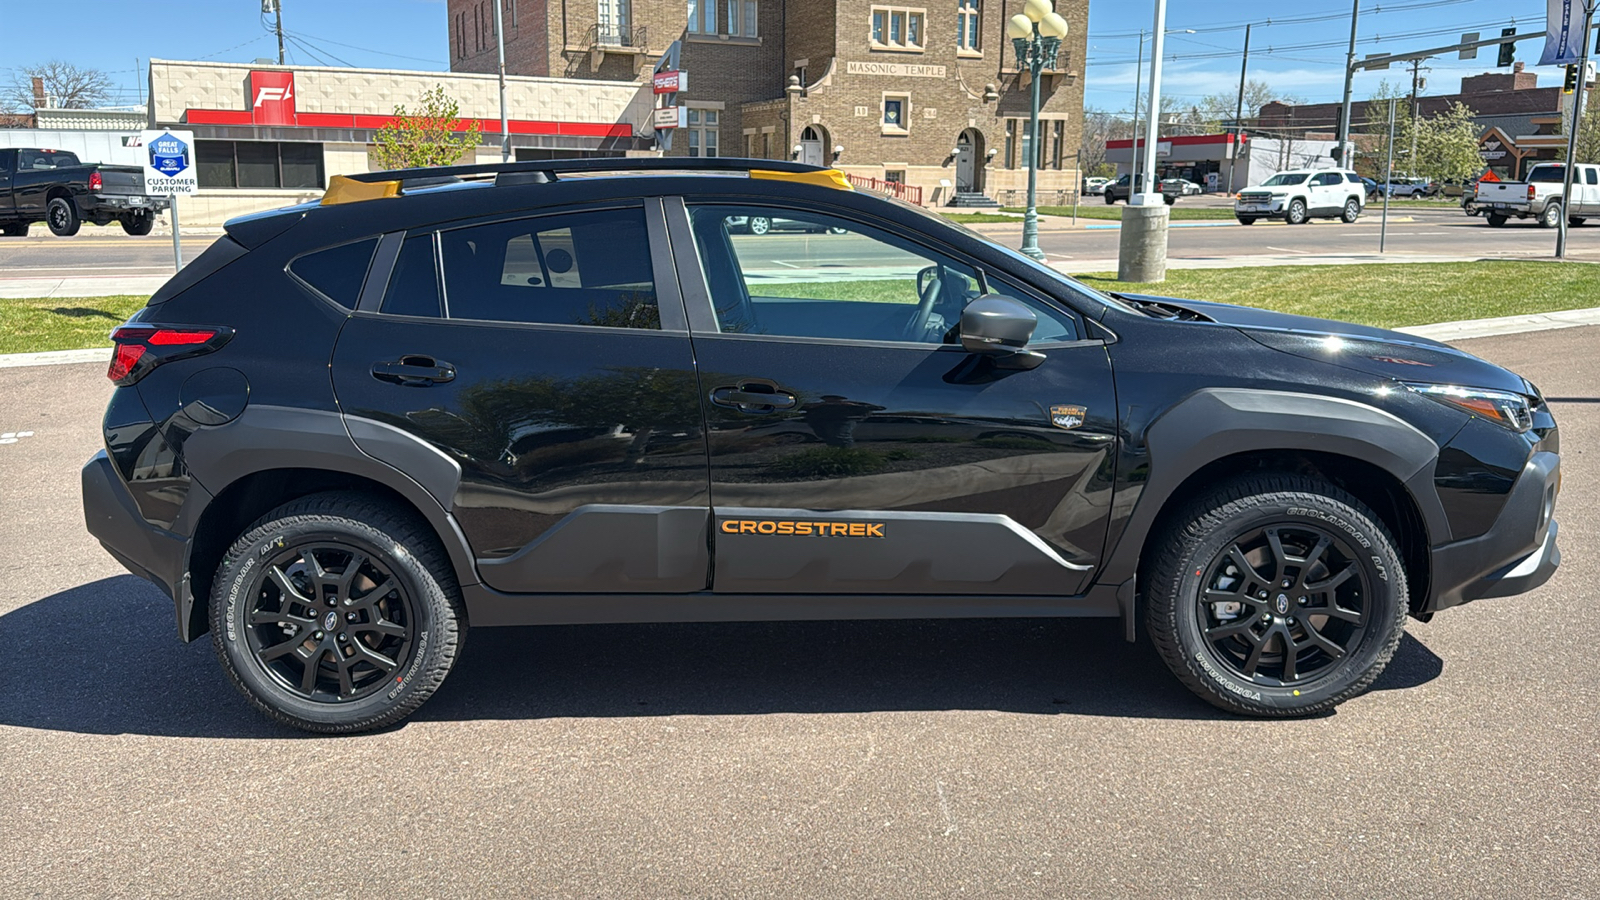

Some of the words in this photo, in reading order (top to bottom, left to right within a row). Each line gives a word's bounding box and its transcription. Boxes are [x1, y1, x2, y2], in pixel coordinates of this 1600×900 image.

[1559, 31, 1568, 56] EVENT
[849, 62, 897, 74] MASONIC
[904, 65, 945, 76] TEMPLE
[147, 178, 195, 186] CUSTOMER
[721, 519, 884, 537] CROSSTREK
[1286, 507, 1371, 548] GEOLANDAR
[1371, 555, 1388, 581] A/T
[226, 557, 256, 641] GEOLANDAR
[260, 535, 284, 555] A/T
[388, 631, 429, 699] YOKOHAMA
[1195, 652, 1261, 701] YOKOHAMA
